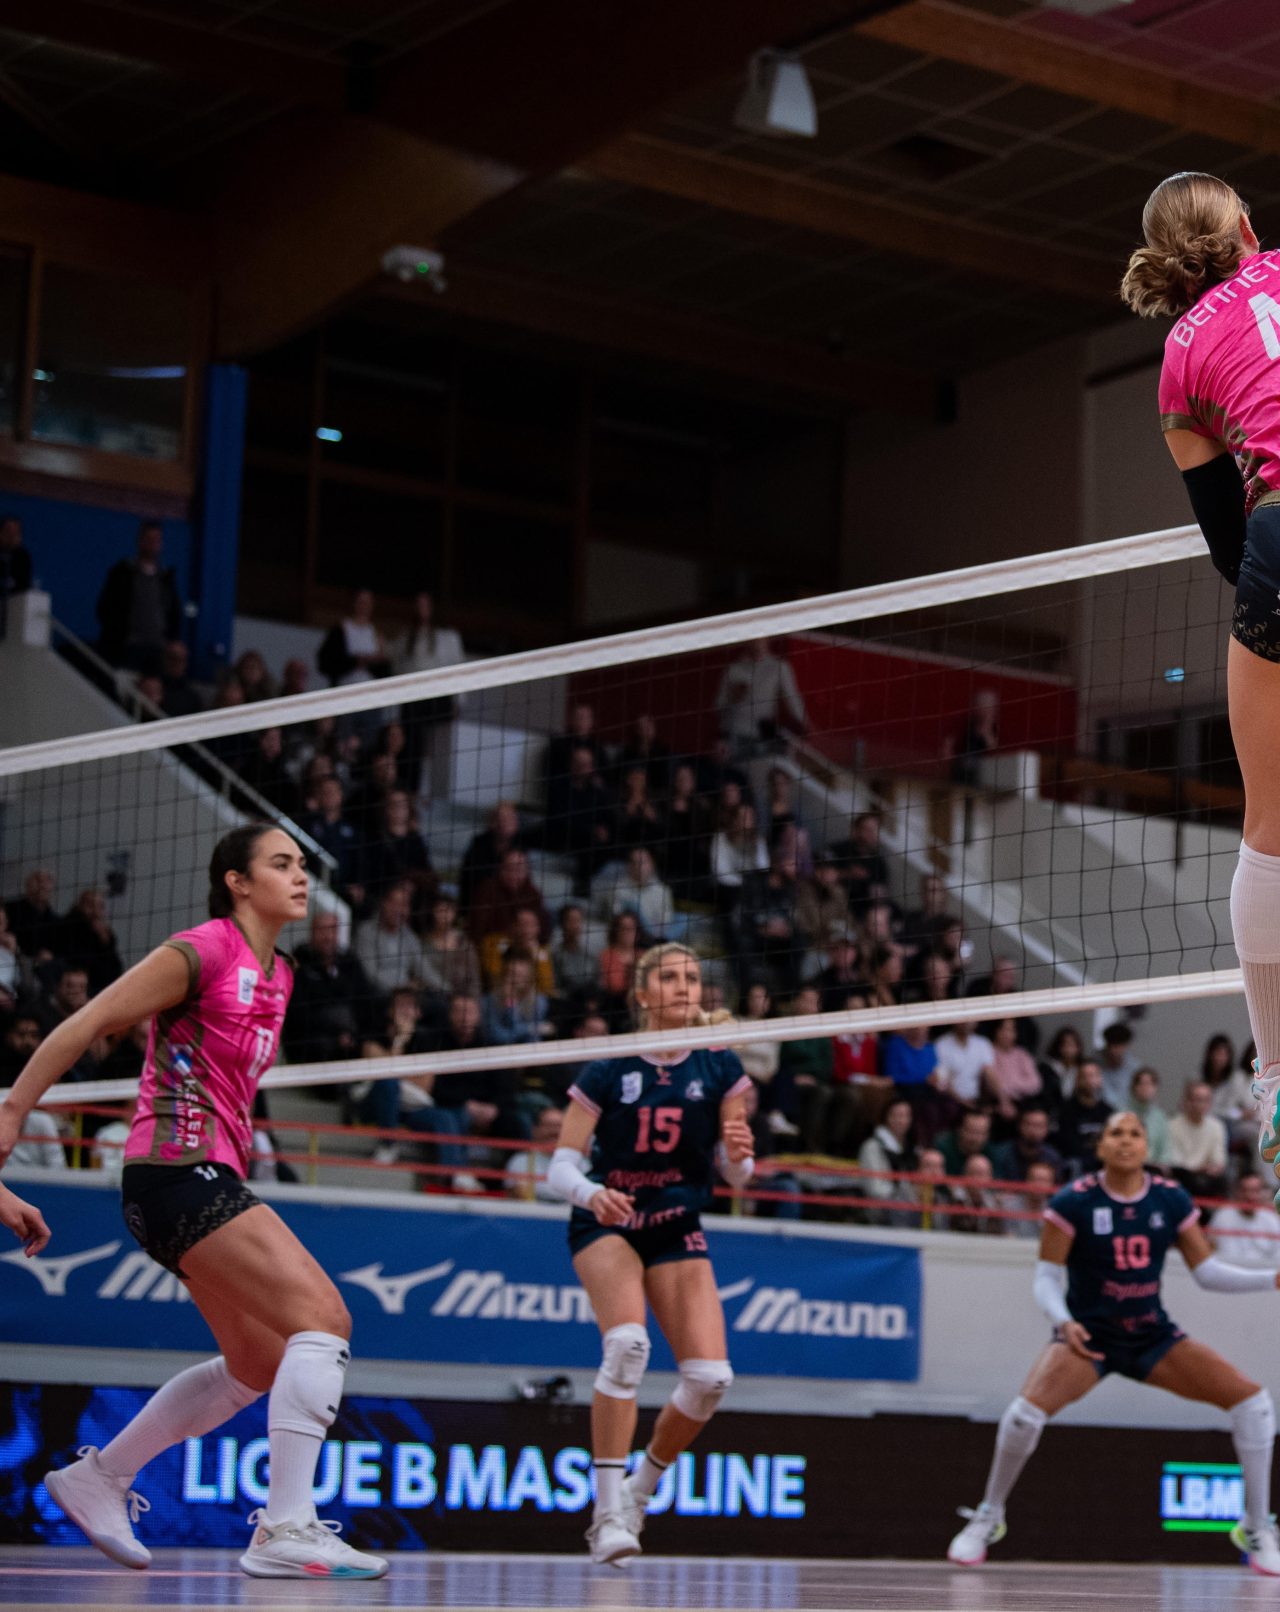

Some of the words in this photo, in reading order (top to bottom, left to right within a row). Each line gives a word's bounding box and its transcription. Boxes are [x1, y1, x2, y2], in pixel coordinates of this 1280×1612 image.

[634, 1106, 684, 1153] 15
[684, 1231, 708, 1251] 15
[1112, 1235, 1151, 1270] 10
[431, 1269, 598, 1325] MIZUN
[392, 1441, 439, 1509] B
